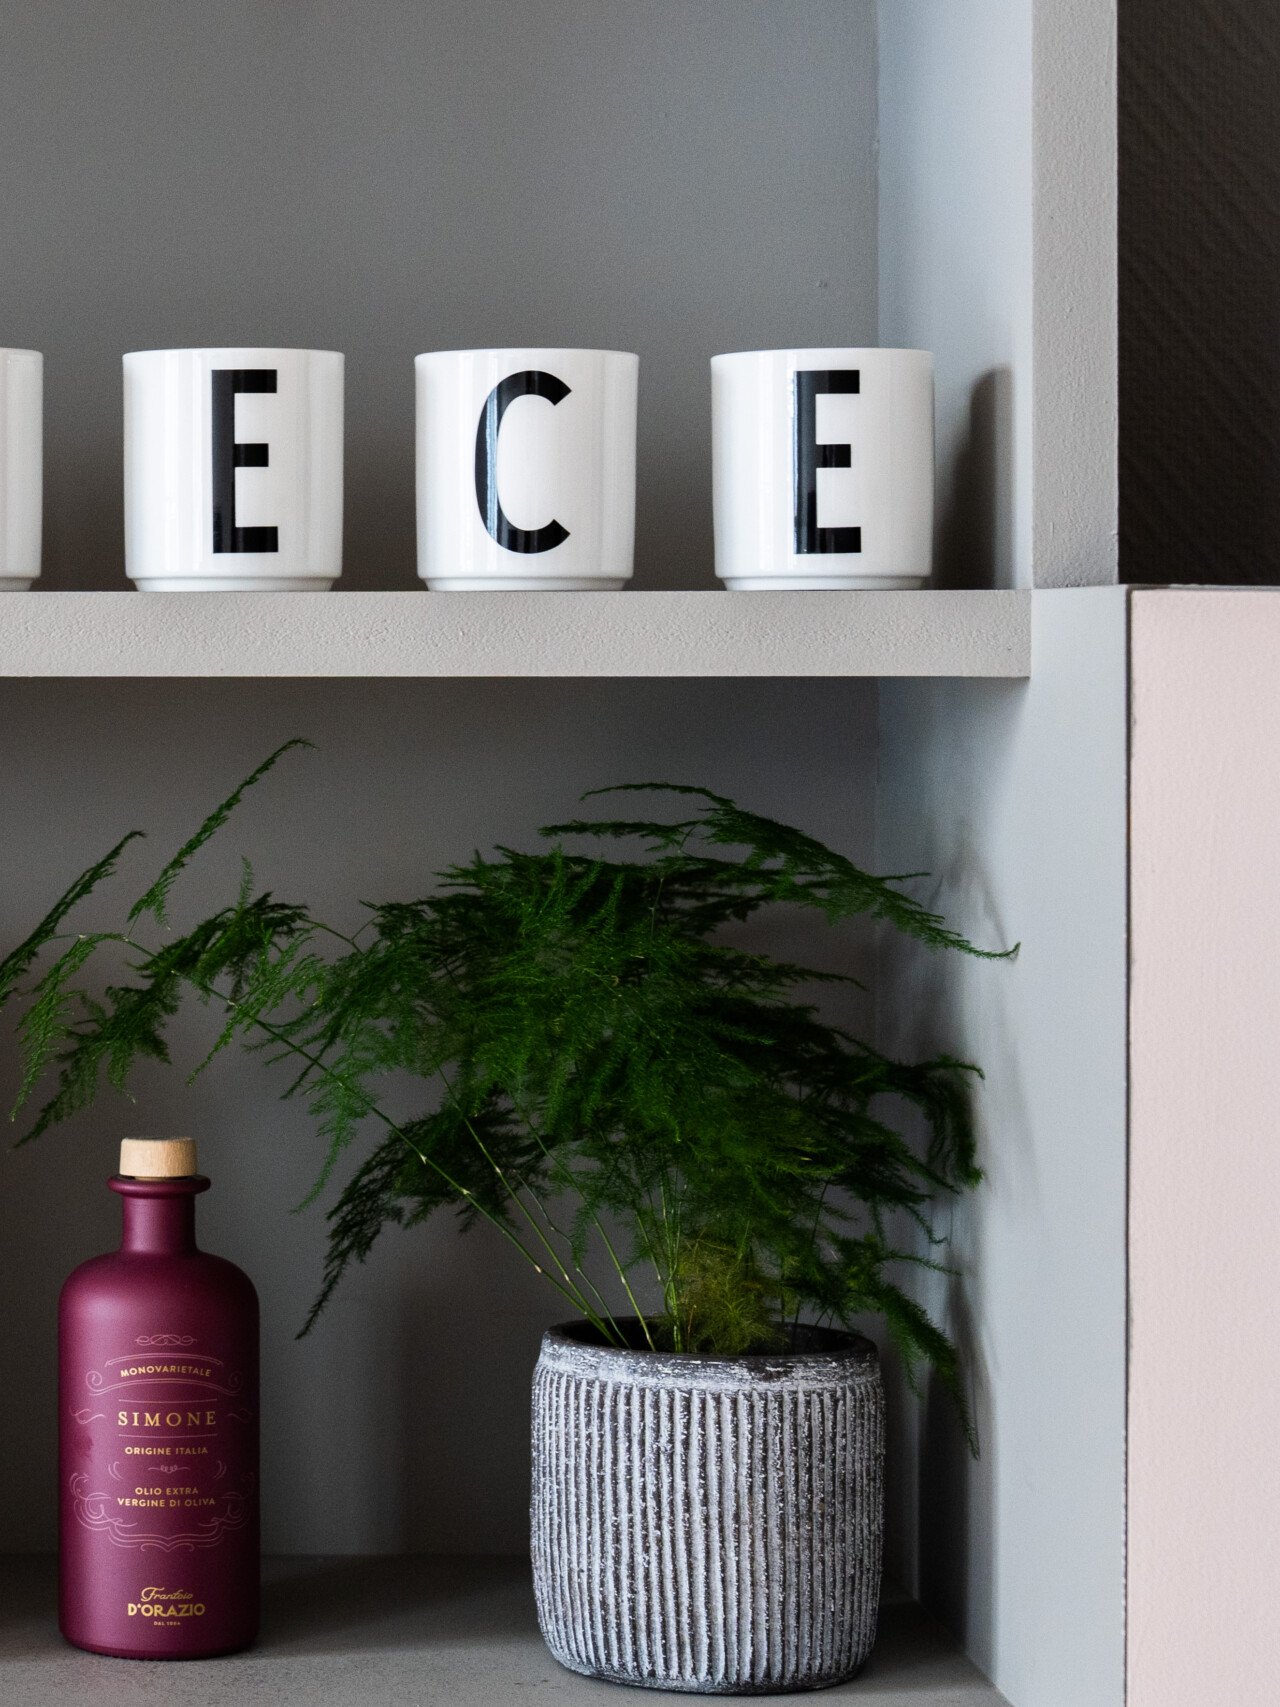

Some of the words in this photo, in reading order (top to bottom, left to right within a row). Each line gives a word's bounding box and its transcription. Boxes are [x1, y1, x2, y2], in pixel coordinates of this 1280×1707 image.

[211, 368, 279, 554] E
[474, 369, 572, 554] C
[793, 369, 863, 554] E
[120, 1364, 212, 1378] MONOVARIETALE
[117, 1410, 217, 1427] SIMONE
[124, 1446, 172, 1456] ORIGINE
[175, 1446, 209, 1455] ITALIA
[135, 1487, 162, 1496] OLIO
[166, 1486, 199, 1495] EXTRA
[117, 1497, 166, 1507] VERGINE
[169, 1499, 181, 1508] DI
[184, 1497, 216, 1507] OLIVA
[140, 1586, 194, 1602] Frantoio
